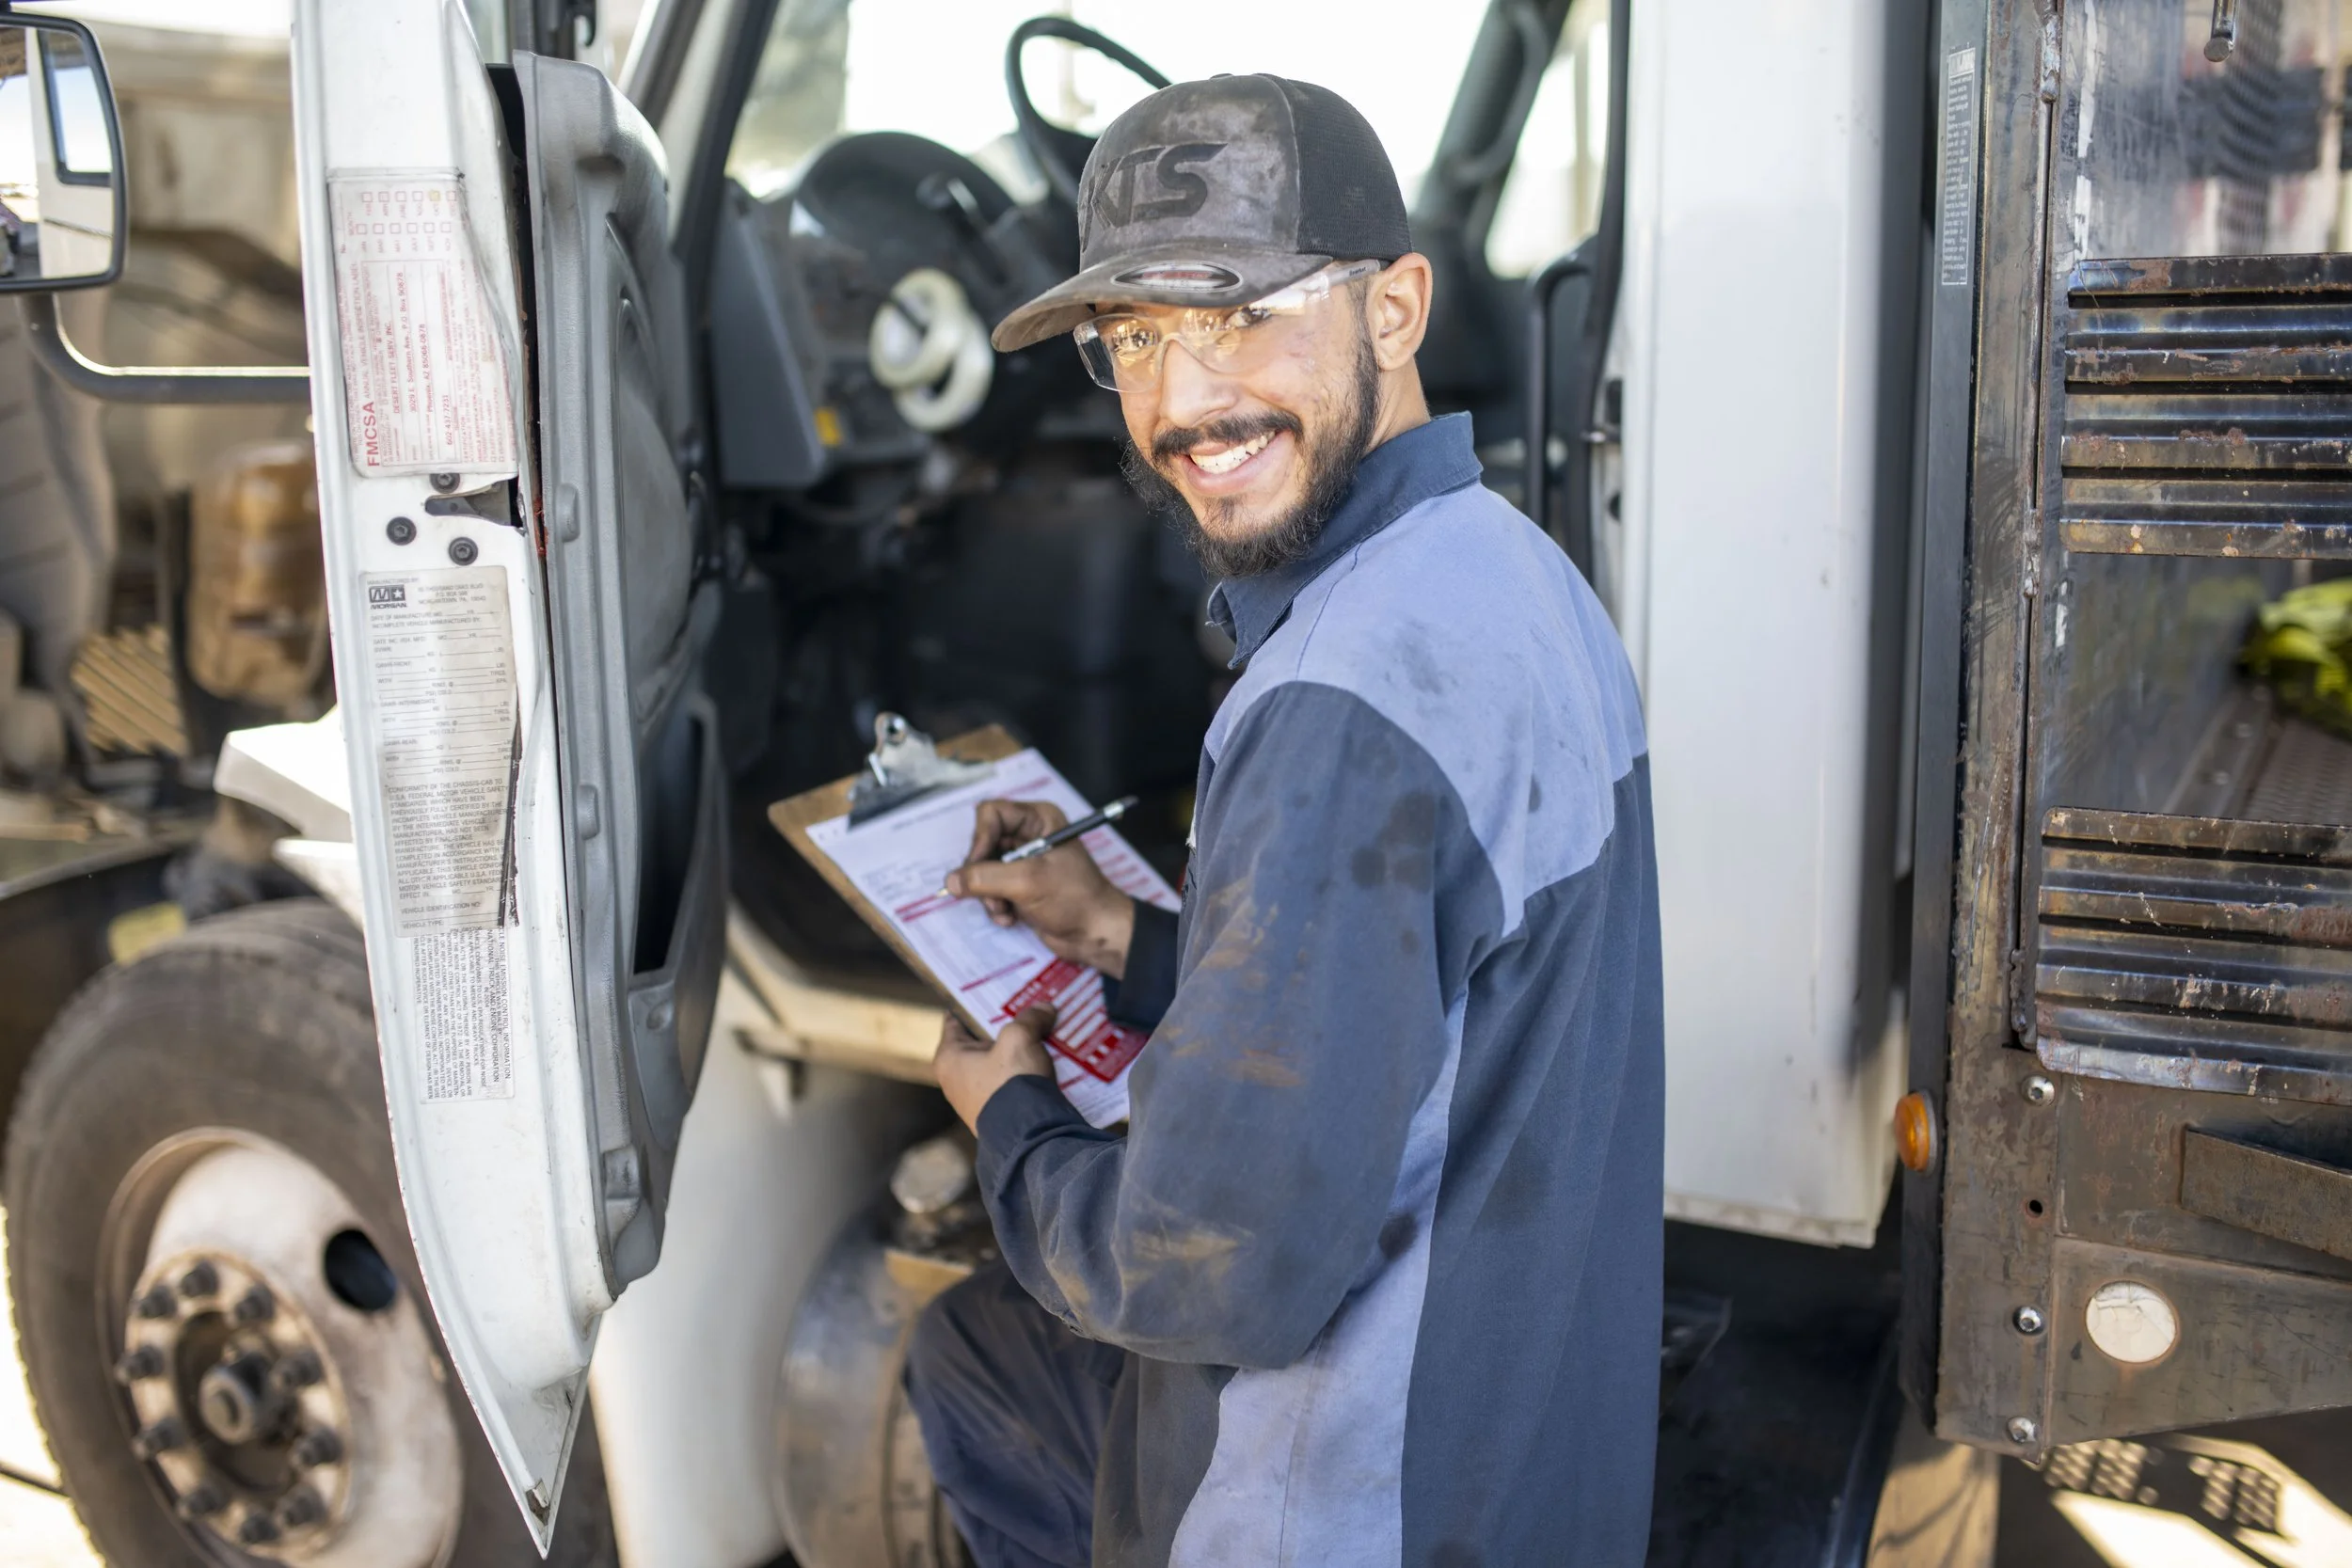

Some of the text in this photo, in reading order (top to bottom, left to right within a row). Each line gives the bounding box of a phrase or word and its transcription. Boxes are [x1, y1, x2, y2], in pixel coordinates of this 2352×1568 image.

[353, 288, 364, 333] INSPECTION
[358, 336, 367, 366] VEHICLE
[405, 351, 414, 382] Southern
[423, 371, 430, 380] AZ
[362, 372, 371, 399] ANNUAL
[391, 387, 400, 414] DESERT
[362, 402, 380, 467] FMCSA
